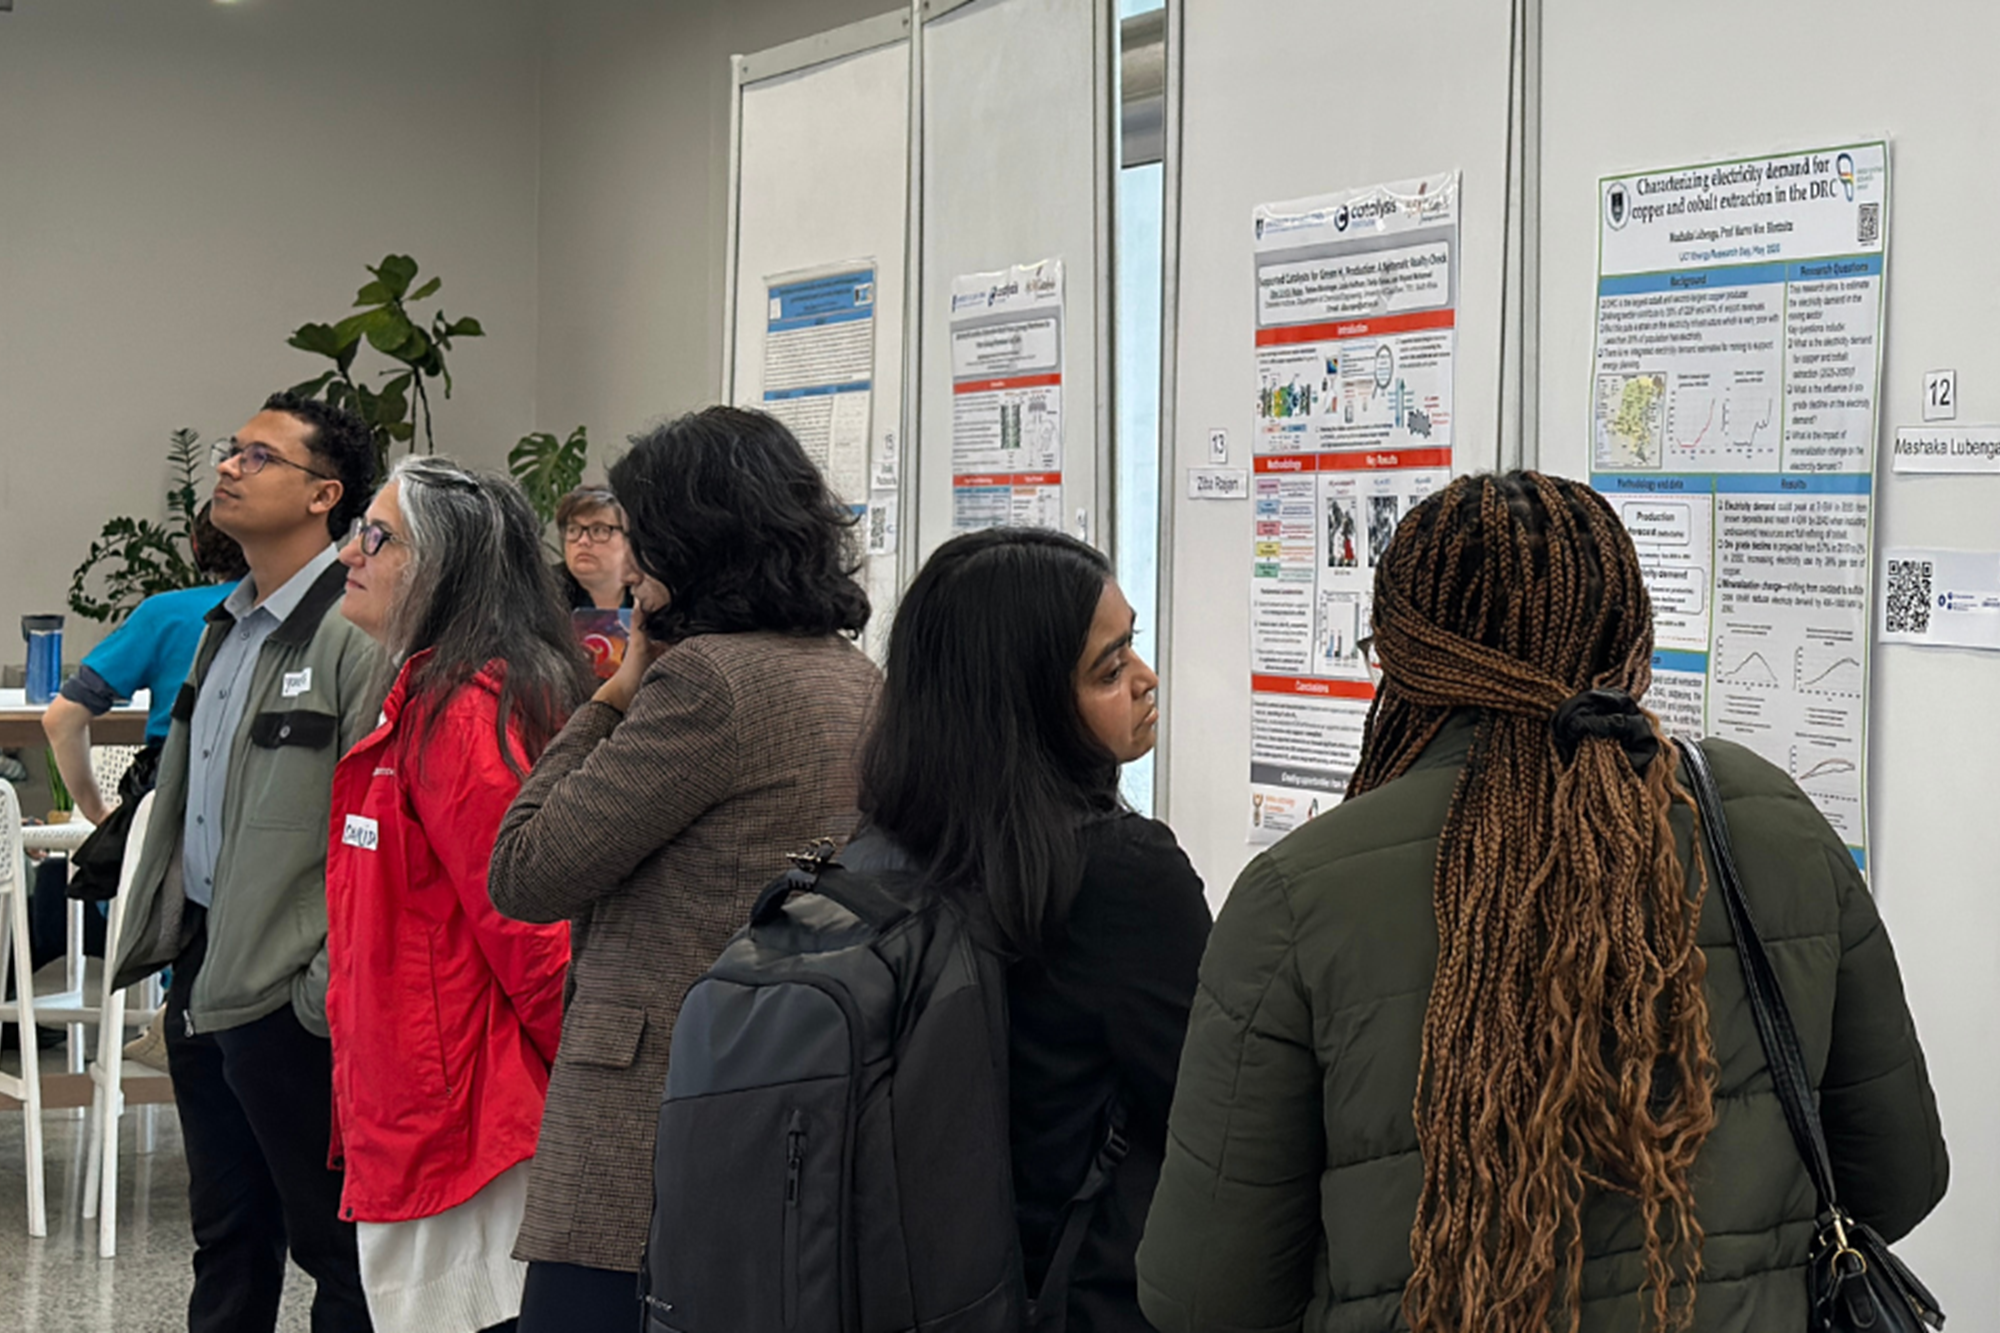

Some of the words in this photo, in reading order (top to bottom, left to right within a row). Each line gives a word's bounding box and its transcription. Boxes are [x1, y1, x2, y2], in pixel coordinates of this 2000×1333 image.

[1636, 171, 1710, 196] Characterizing
[1711, 164, 1764, 191] electricity
[1765, 156, 1810, 181] demand
[1812, 155, 1831, 175] for
[1351, 196, 1397, 219] catalysis
[1632, 204, 1665, 224] copper
[1666, 196, 1685, 215] and
[1687, 192, 1718, 213] cobalt
[1720, 188, 1773, 209] extraction
[1775, 185, 1787, 203] in
[1789, 182, 1807, 202] the
[1810, 178, 1839, 200] DRC
[1930, 378, 1951, 406] 12
[1894, 438, 1948, 456] Mashaka
[1950, 438, 2000, 461] Lubenga
[1636, 511, 1676, 522] Production
[1659, 569, 1688, 580] demand
